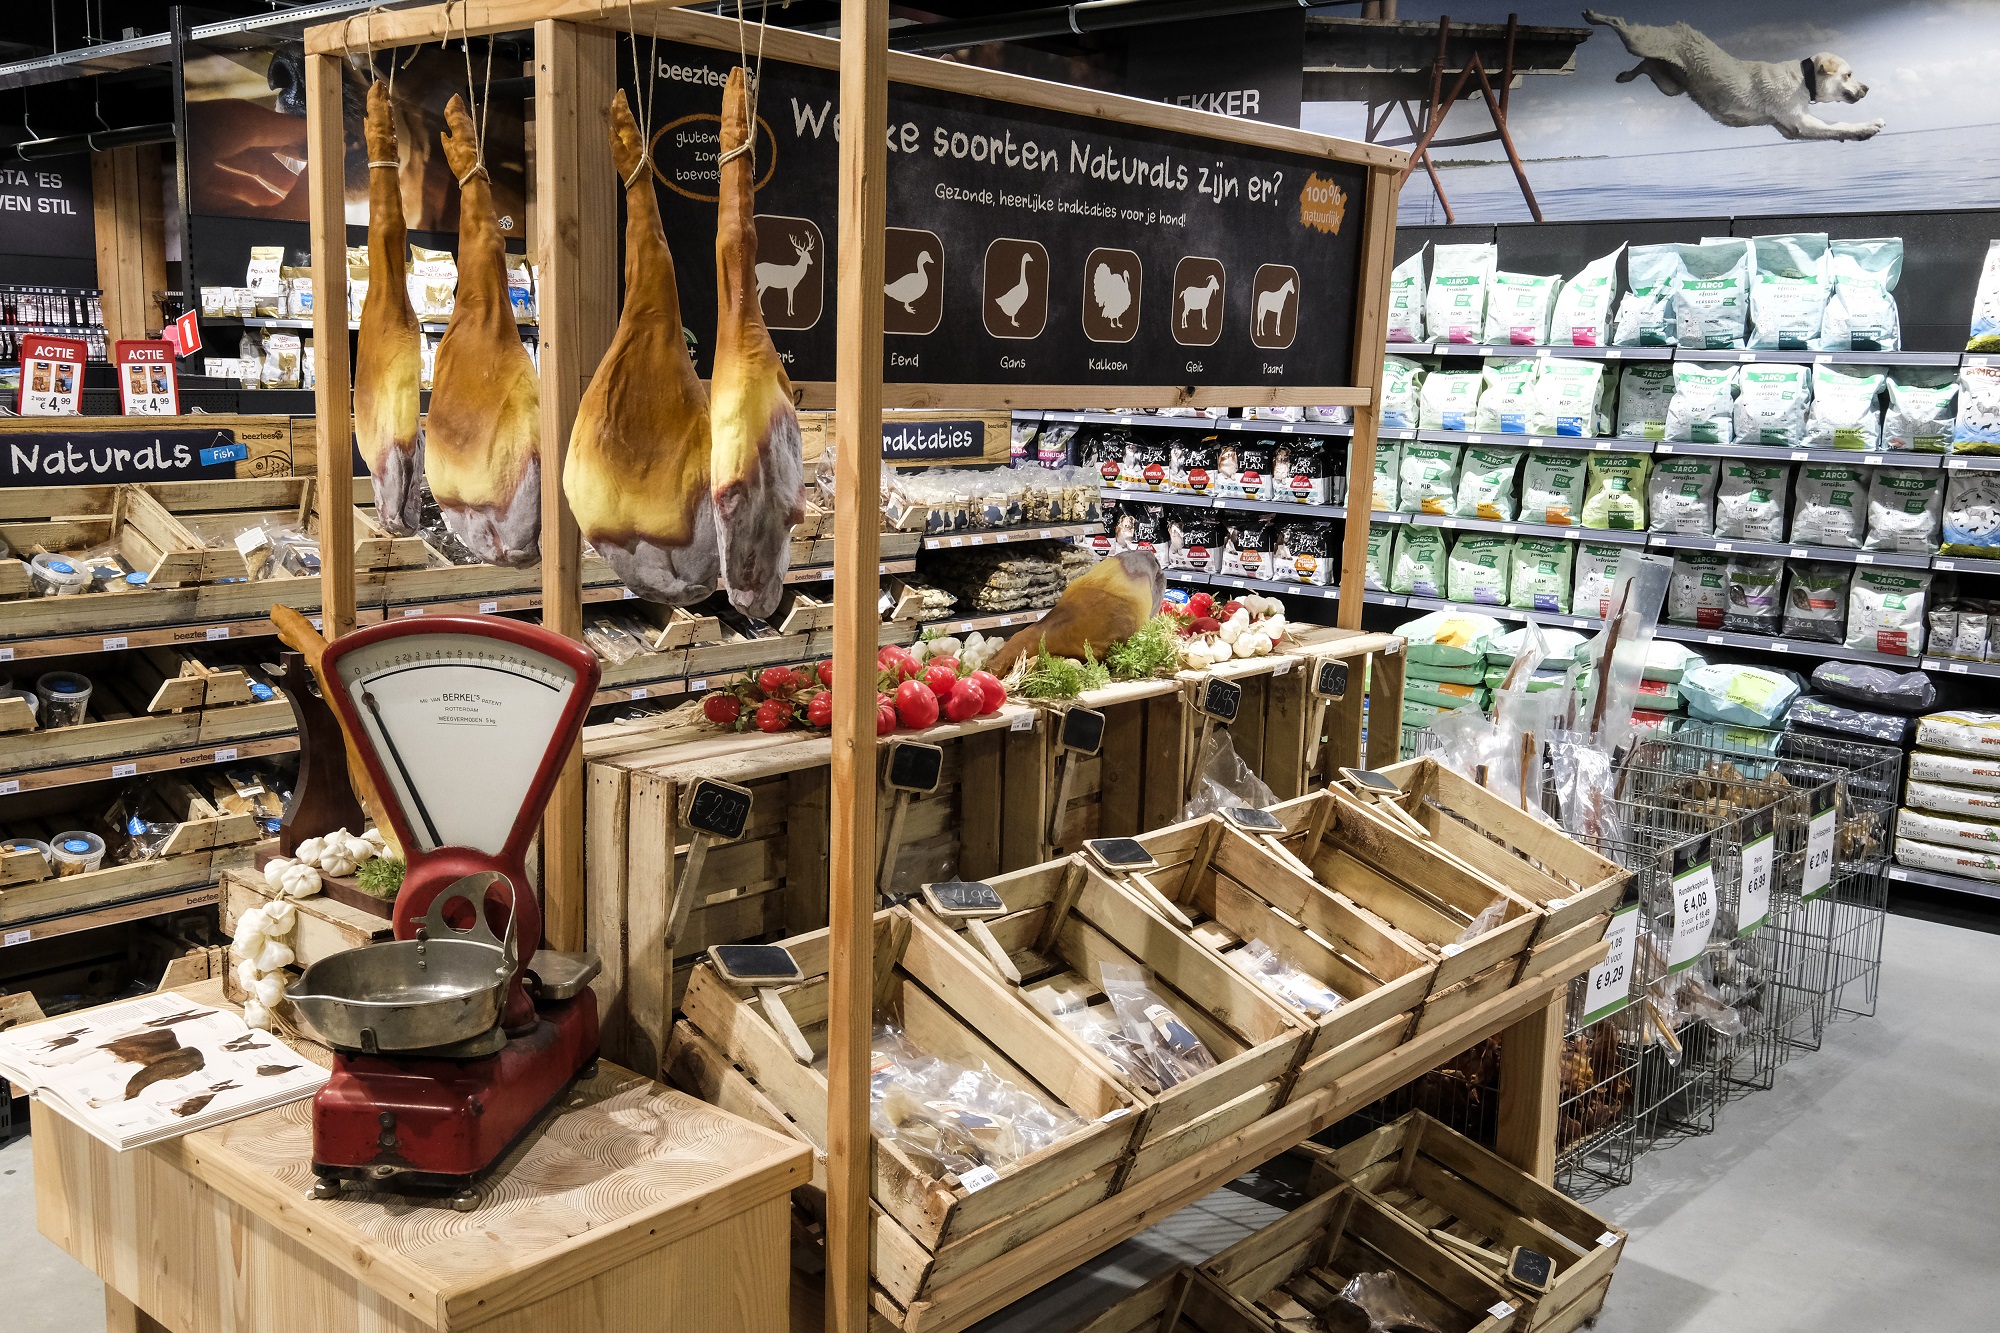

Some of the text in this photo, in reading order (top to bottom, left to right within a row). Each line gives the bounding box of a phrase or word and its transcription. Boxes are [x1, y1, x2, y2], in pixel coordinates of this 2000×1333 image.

[658, 58, 729, 88] beeztee
[933, 126, 1059, 173] soorten
[1069, 139, 1190, 191] Naturals
[1198, 161, 1240, 205] zijn
[1248, 170, 1284, 207] er?
[1305, 185, 1341, 206] 100%
[37, 197, 77, 215] STIL
[934, 183, 1187, 228] Gezonde, heerlijke traktaties voor je hond!
[1303, 208, 1341, 227] natuurlijk
[1695, 281, 1724, 289] JARCO
[34, 346, 75, 360] ACTIE
[128, 349, 165, 360] ACTIE
[891, 352, 919, 367] Eend
[1000, 355, 1026, 369] Gans
[1088, 358, 1128, 371] Kalkoen
[1185, 360, 1204, 373] Geit
[1262, 363, 1284, 375] Paard
[1500, 365, 1522, 374] JARCO
[1642, 370, 1667, 378] JARCO
[1758, 372, 1786, 382] JARCO
[40, 396, 71, 413] € 4,99
[149, 397, 170, 413] 4,99
[882, 425, 973, 452] raktaties
[10, 438, 193, 475] Naturals
[213, 450, 235, 460] Fish
[1244, 455, 1261, 463] PRO
[1417, 450, 1439, 458] JARCO
[1240, 461, 1264, 470] PLAN
[1672, 465, 1698, 473] JARCO
[1893, 481, 1925, 489] JARCO
[1185, 536, 1210, 545] PLAN
[1692, 556, 1717, 564] JARCO
[1874, 576, 1906, 586] JARCO
[173, 631, 207, 641] beeztee
[354, 667, 361, 676] 0
[481, 698, 503, 706] PATENT
[1919, 733, 1950, 746] Classic
[1912, 767, 1941, 778] Classic
[1908, 796, 1937, 808] Classic
[1899, 826, 1928, 838] Classic
[1809, 849, 1829, 870] € 2,09
[1897, 854, 1926, 866] Classic
[1748, 873, 1766, 893] € 6,99
[186, 892, 219, 906] beeztee
[1683, 891, 1707, 913] € 4,09
[1610, 952, 1624, 964] voor
[1596, 965, 1624, 991] € 9,29
